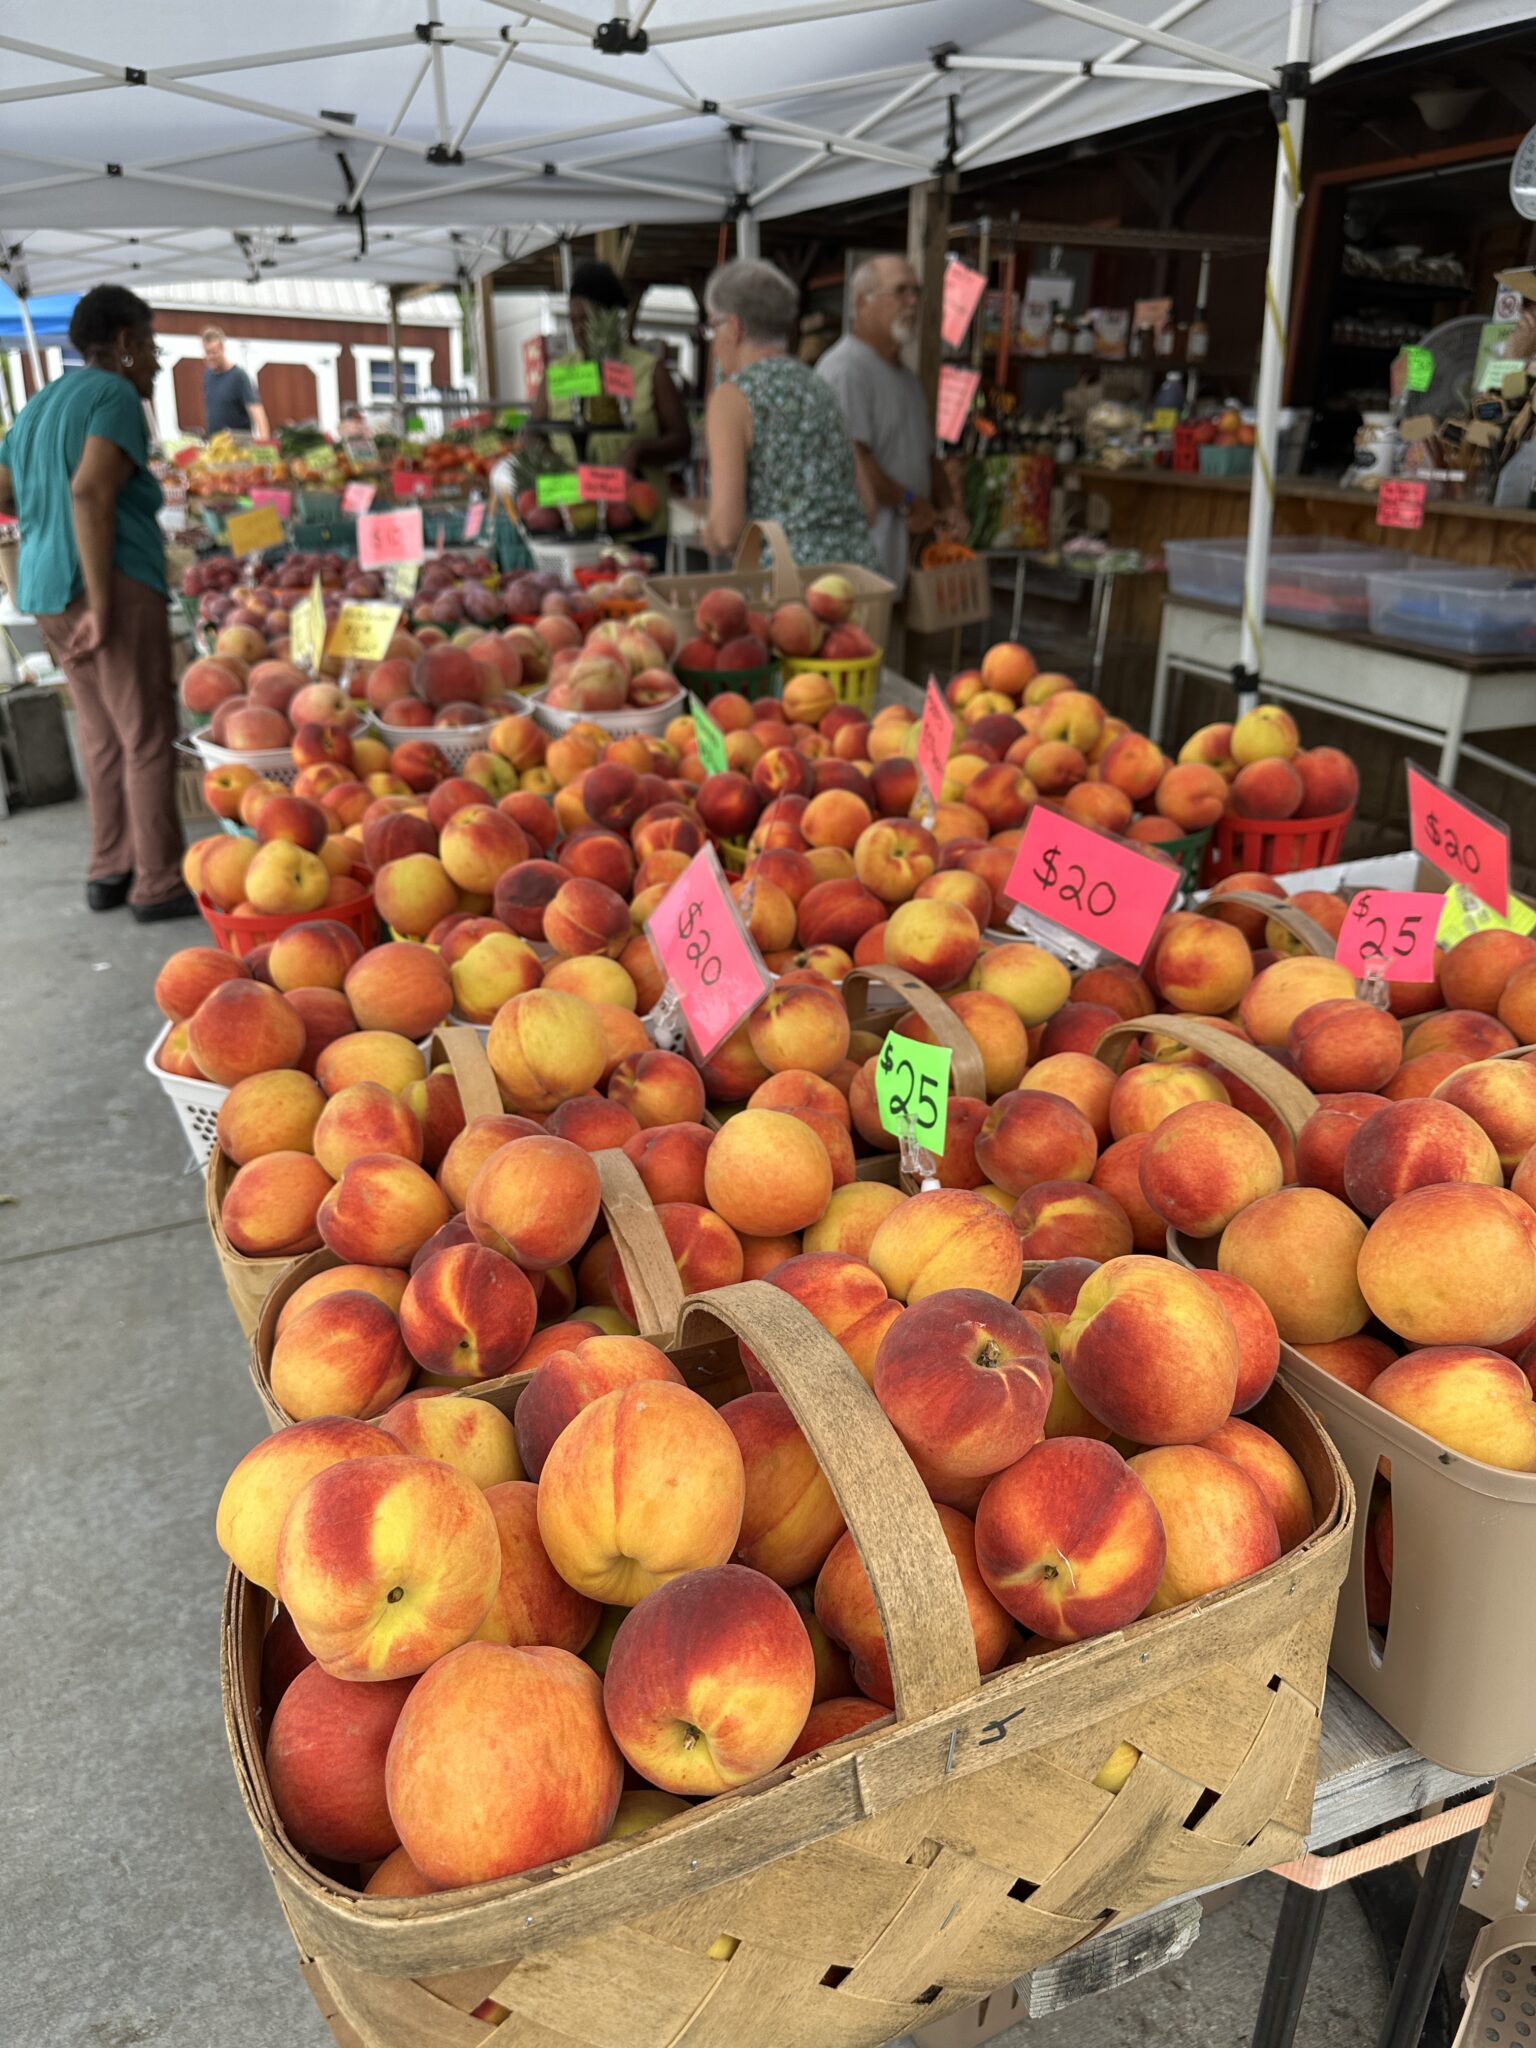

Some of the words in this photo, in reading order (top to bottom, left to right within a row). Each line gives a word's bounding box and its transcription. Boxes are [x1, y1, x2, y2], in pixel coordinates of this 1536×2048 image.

[1424, 811, 1480, 874] $20
[1033, 845, 1116, 916] $20
[678, 900, 723, 986] $20
[1353, 895, 1423, 961] $25
[880, 1041, 939, 1129] $25
